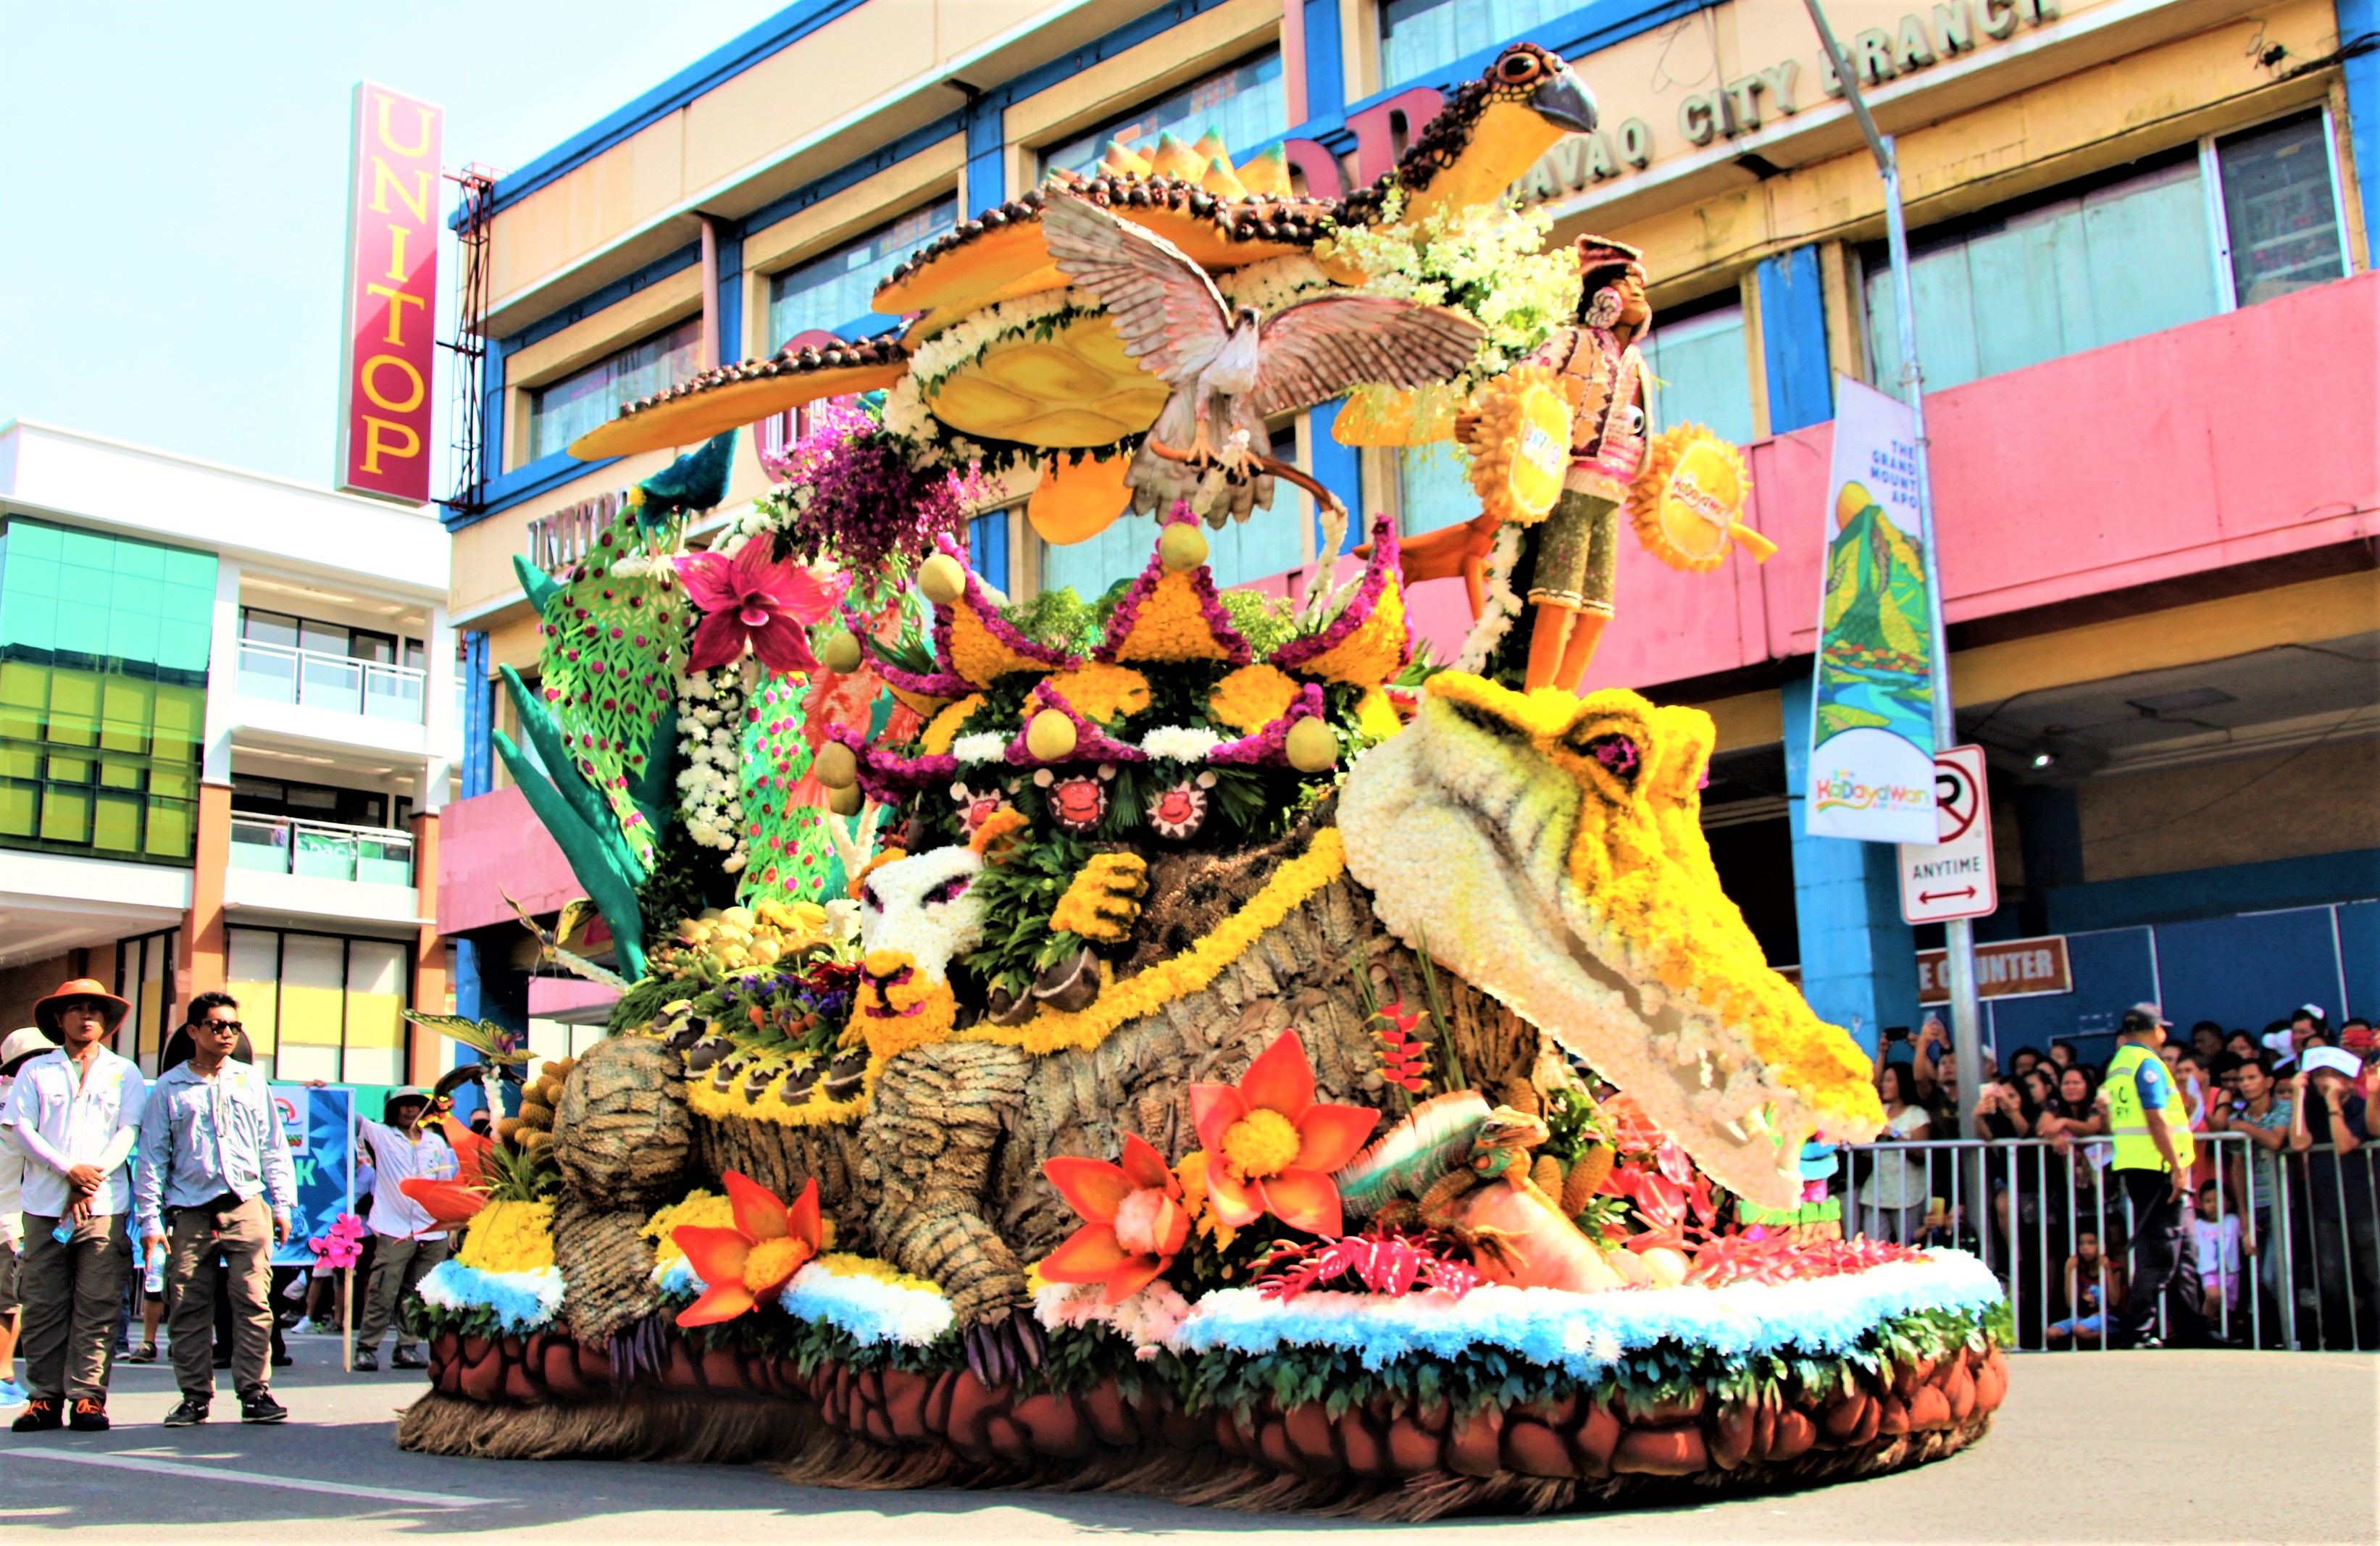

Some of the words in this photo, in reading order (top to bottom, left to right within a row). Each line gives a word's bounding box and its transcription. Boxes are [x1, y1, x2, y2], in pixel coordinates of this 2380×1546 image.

[1679, 58, 1800, 146] CITY
[360, 95, 435, 475] UNITOP
[1871, 448, 1916, 477] GRAND
[1891, 439, 1915, 460] THE
[1871, 464, 1916, 493] MOUNT
[1891, 490, 1918, 509] APO
[1913, 856, 1982, 879] ANYTIME
[1937, 949, 2054, 988] CUNTER
